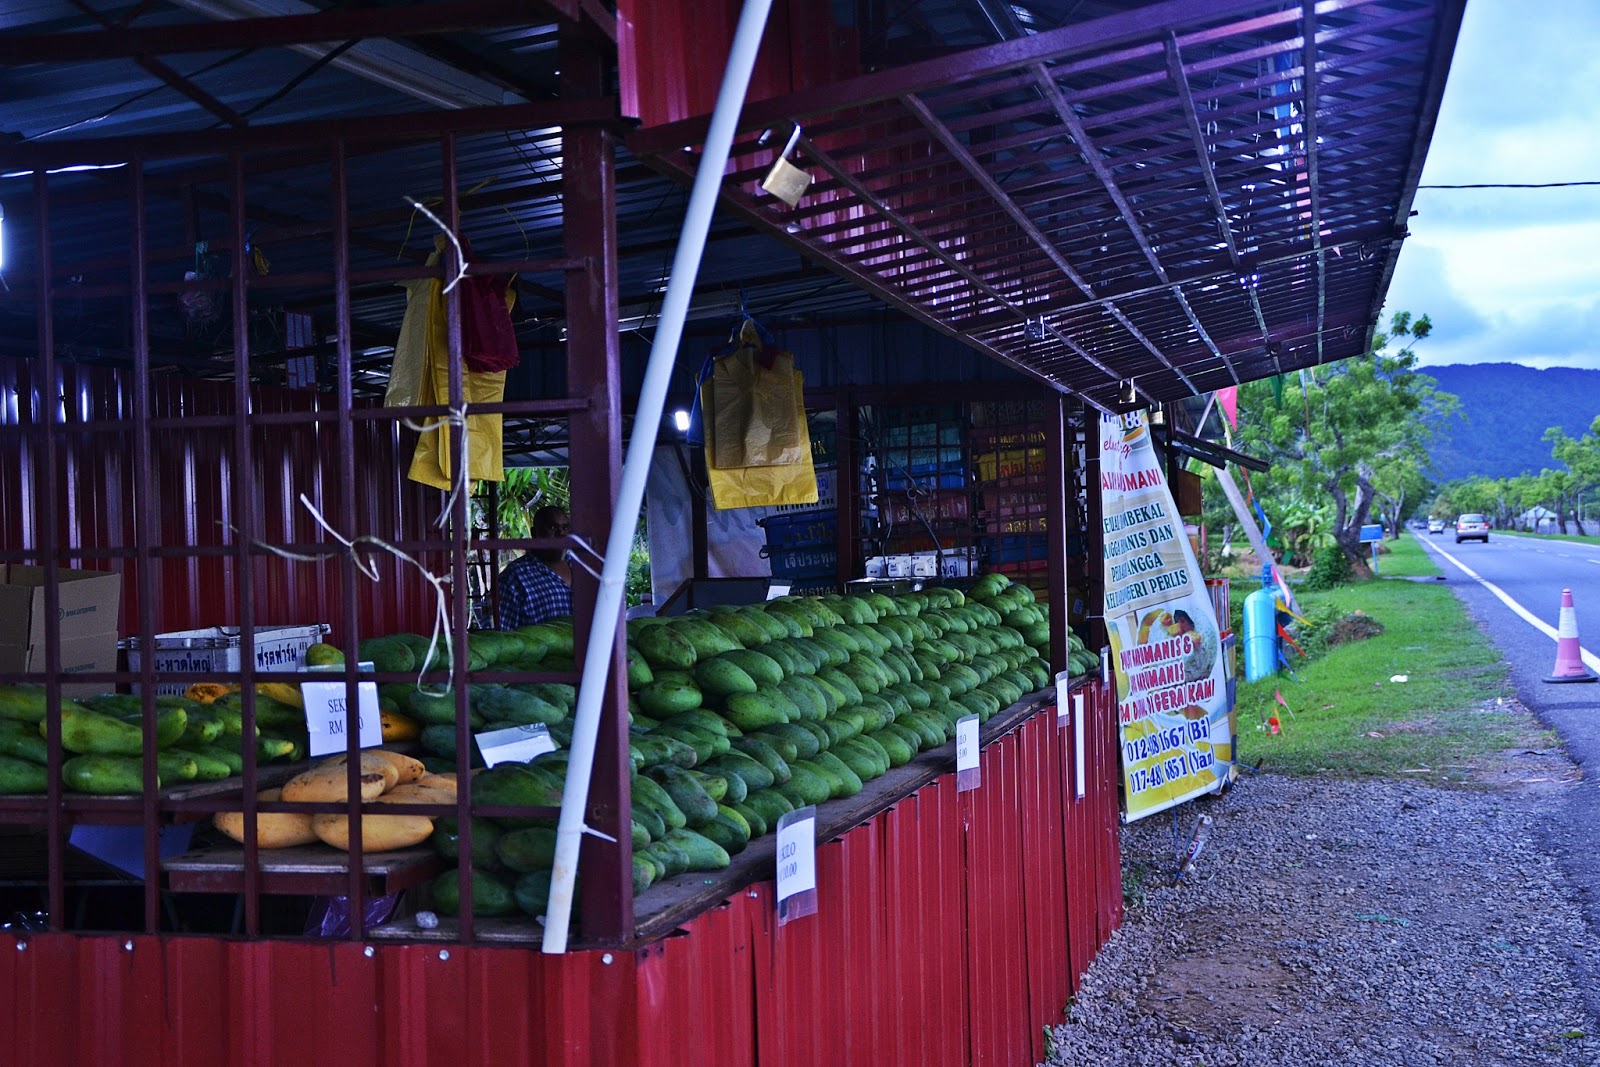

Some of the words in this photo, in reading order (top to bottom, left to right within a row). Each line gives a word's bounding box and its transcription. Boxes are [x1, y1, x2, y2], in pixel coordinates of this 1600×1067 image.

[1148, 524, 1174, 544] DAN
[1149, 569, 1188, 594] PERLIS
[1183, 636, 1192, 654] &
[327, 698, 347, 713] SEK
[328, 719, 343, 735] RM
[1187, 716, 1211, 744] (Bi)
[1189, 744, 1215, 774] (Yan)
